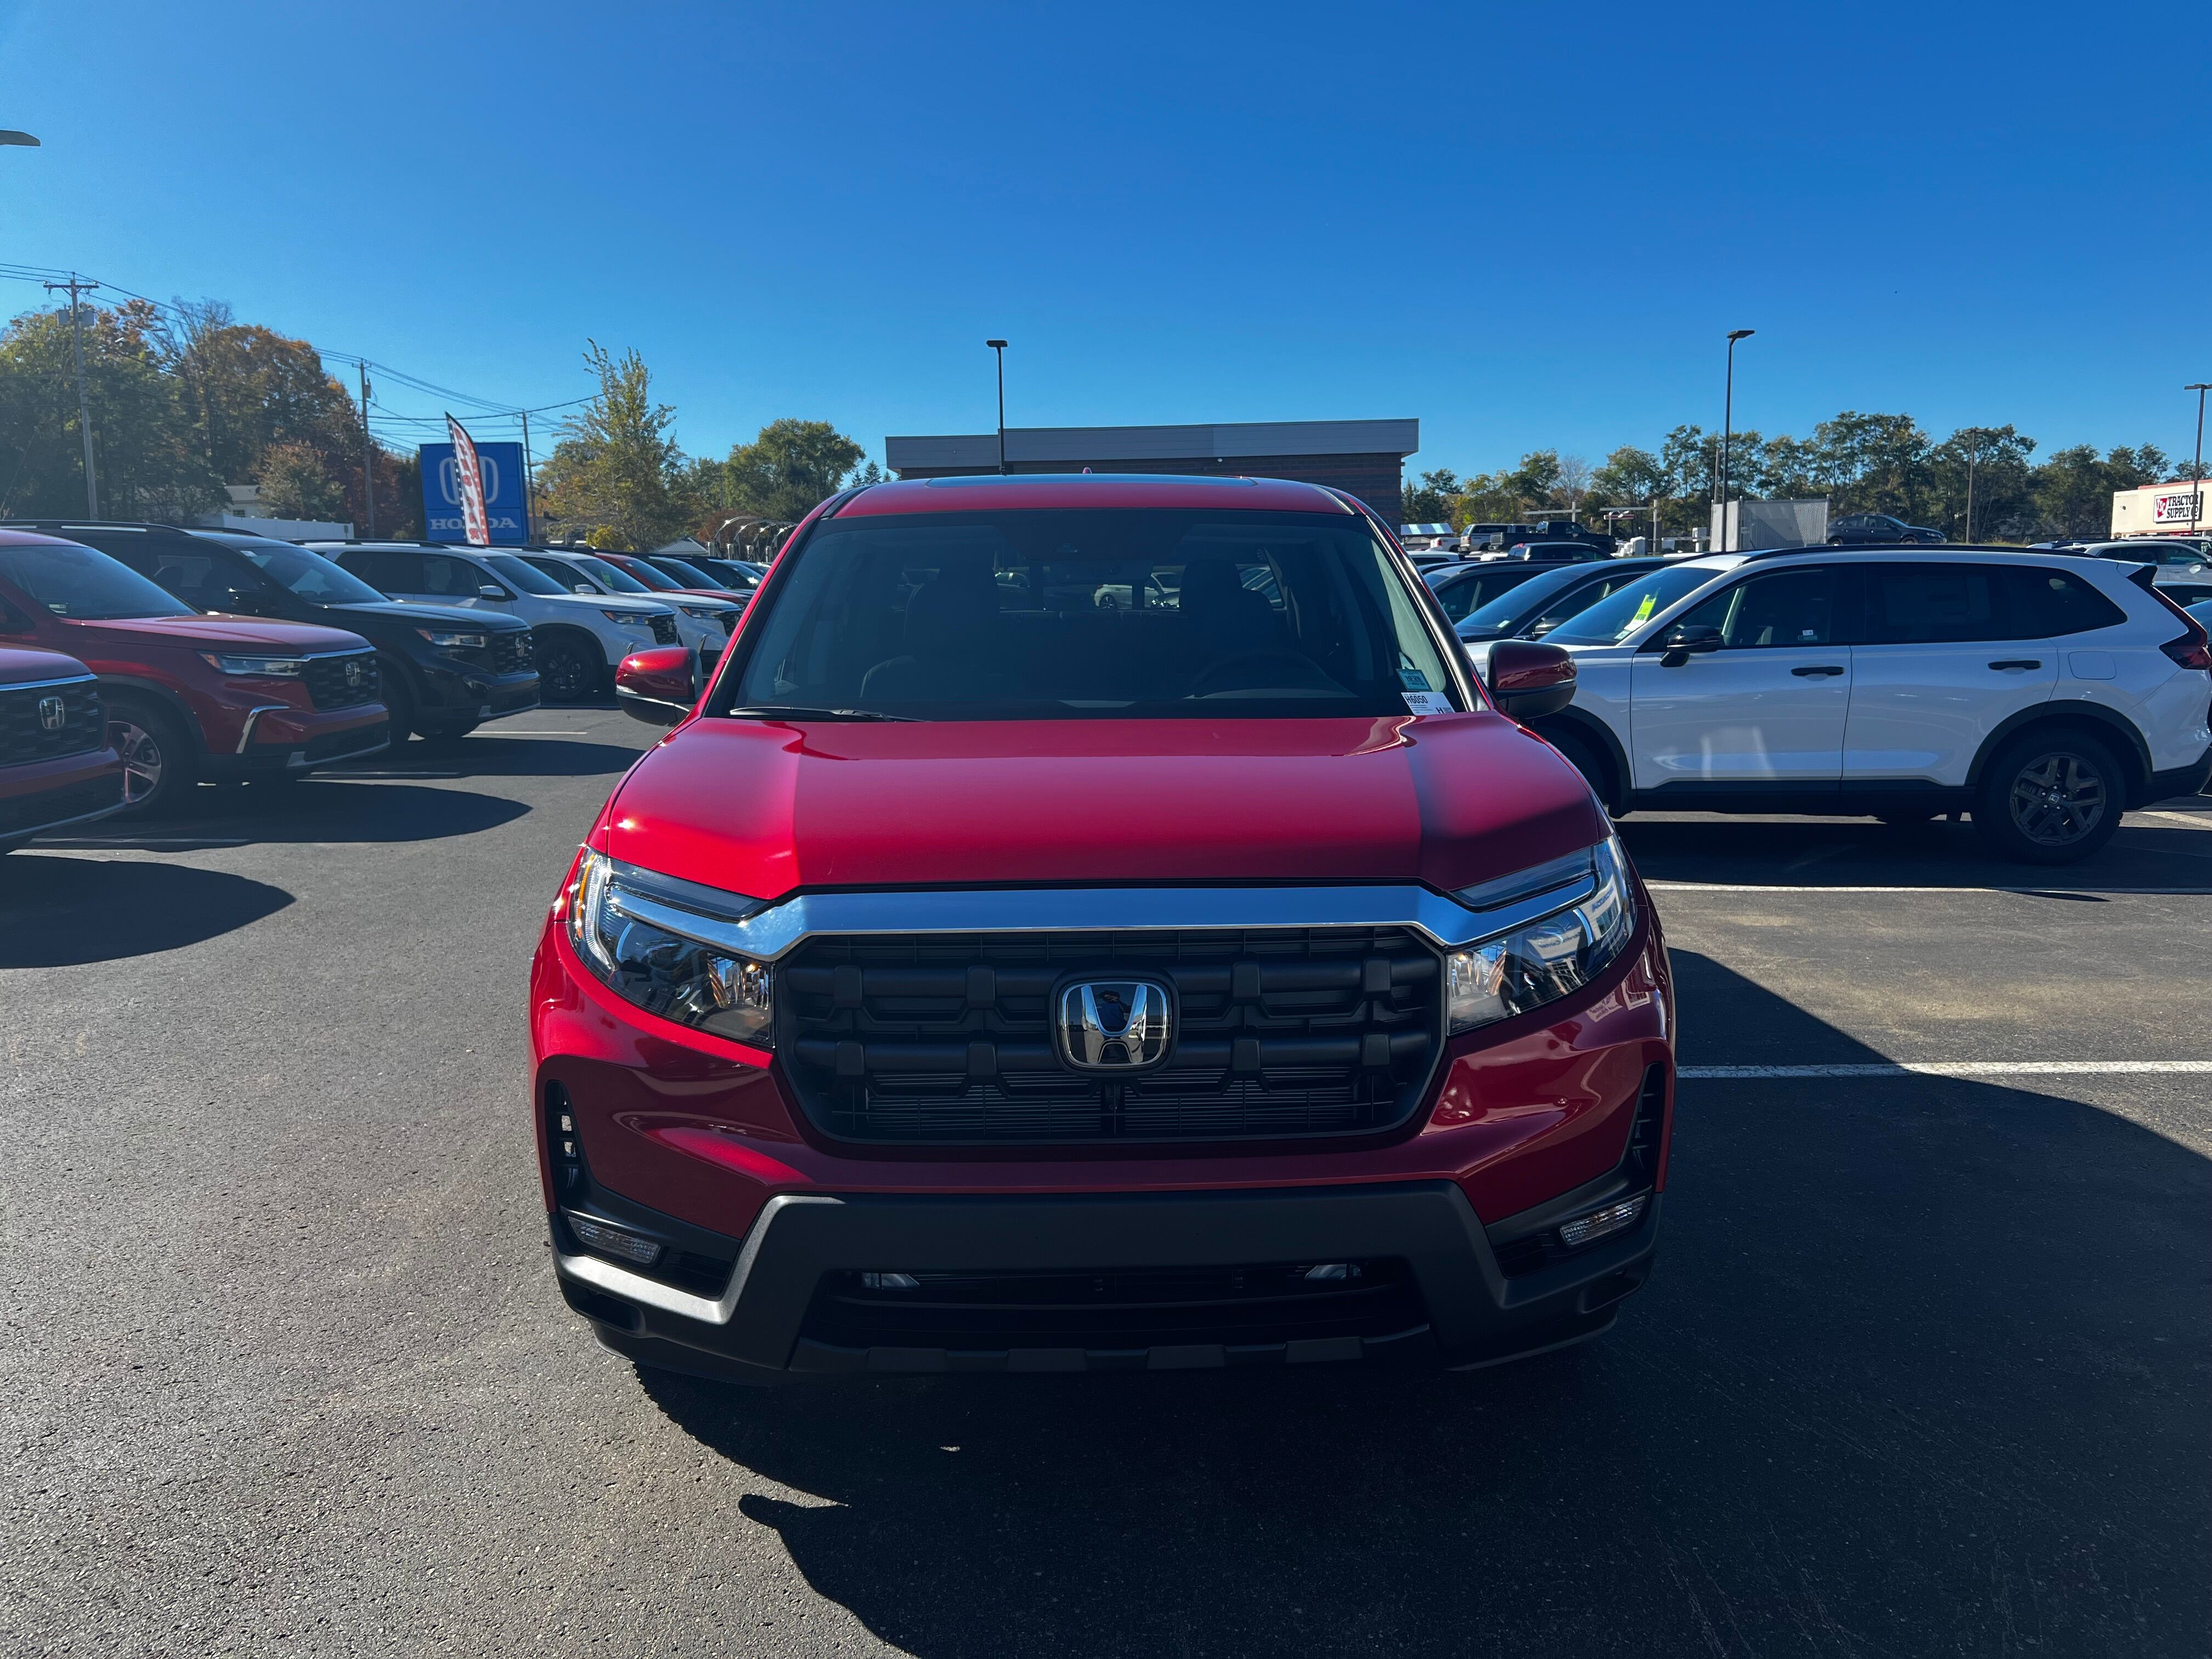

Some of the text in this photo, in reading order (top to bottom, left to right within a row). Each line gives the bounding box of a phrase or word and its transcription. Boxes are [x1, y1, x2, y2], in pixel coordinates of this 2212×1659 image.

[2166, 507, 2191, 518] SUPPLY
[430, 517, 518, 530] HODA
[1404, 696, 1428, 704] H6050
